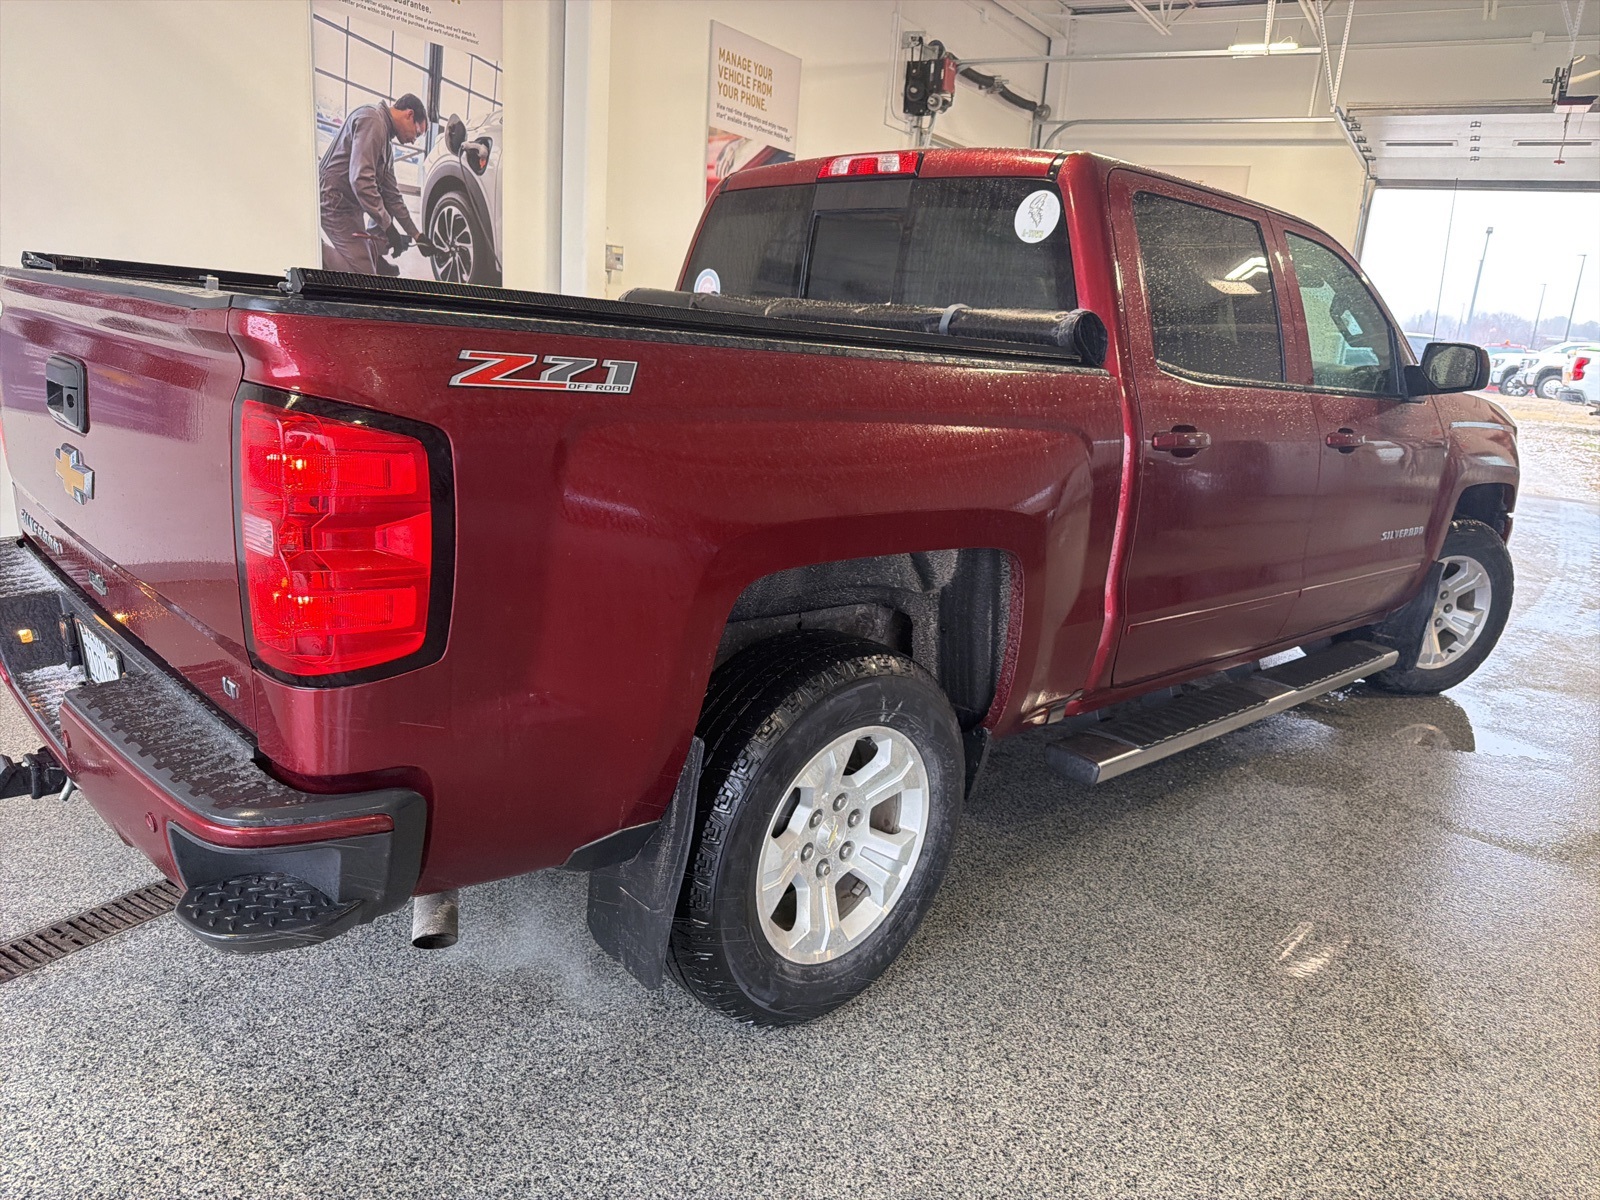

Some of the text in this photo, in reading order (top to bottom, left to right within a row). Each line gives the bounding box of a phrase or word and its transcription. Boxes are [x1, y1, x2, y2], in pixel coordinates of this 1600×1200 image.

[719, 47, 773, 82] MANAGE YOUR
[717, 81, 767, 112] YOUR PHONE.
[718, 64, 773, 98] VEHICLE FROM
[449, 350, 638, 388] Z71
[1381, 526, 1424, 541] SILVERADO
[222, 676, 239, 700] LT
